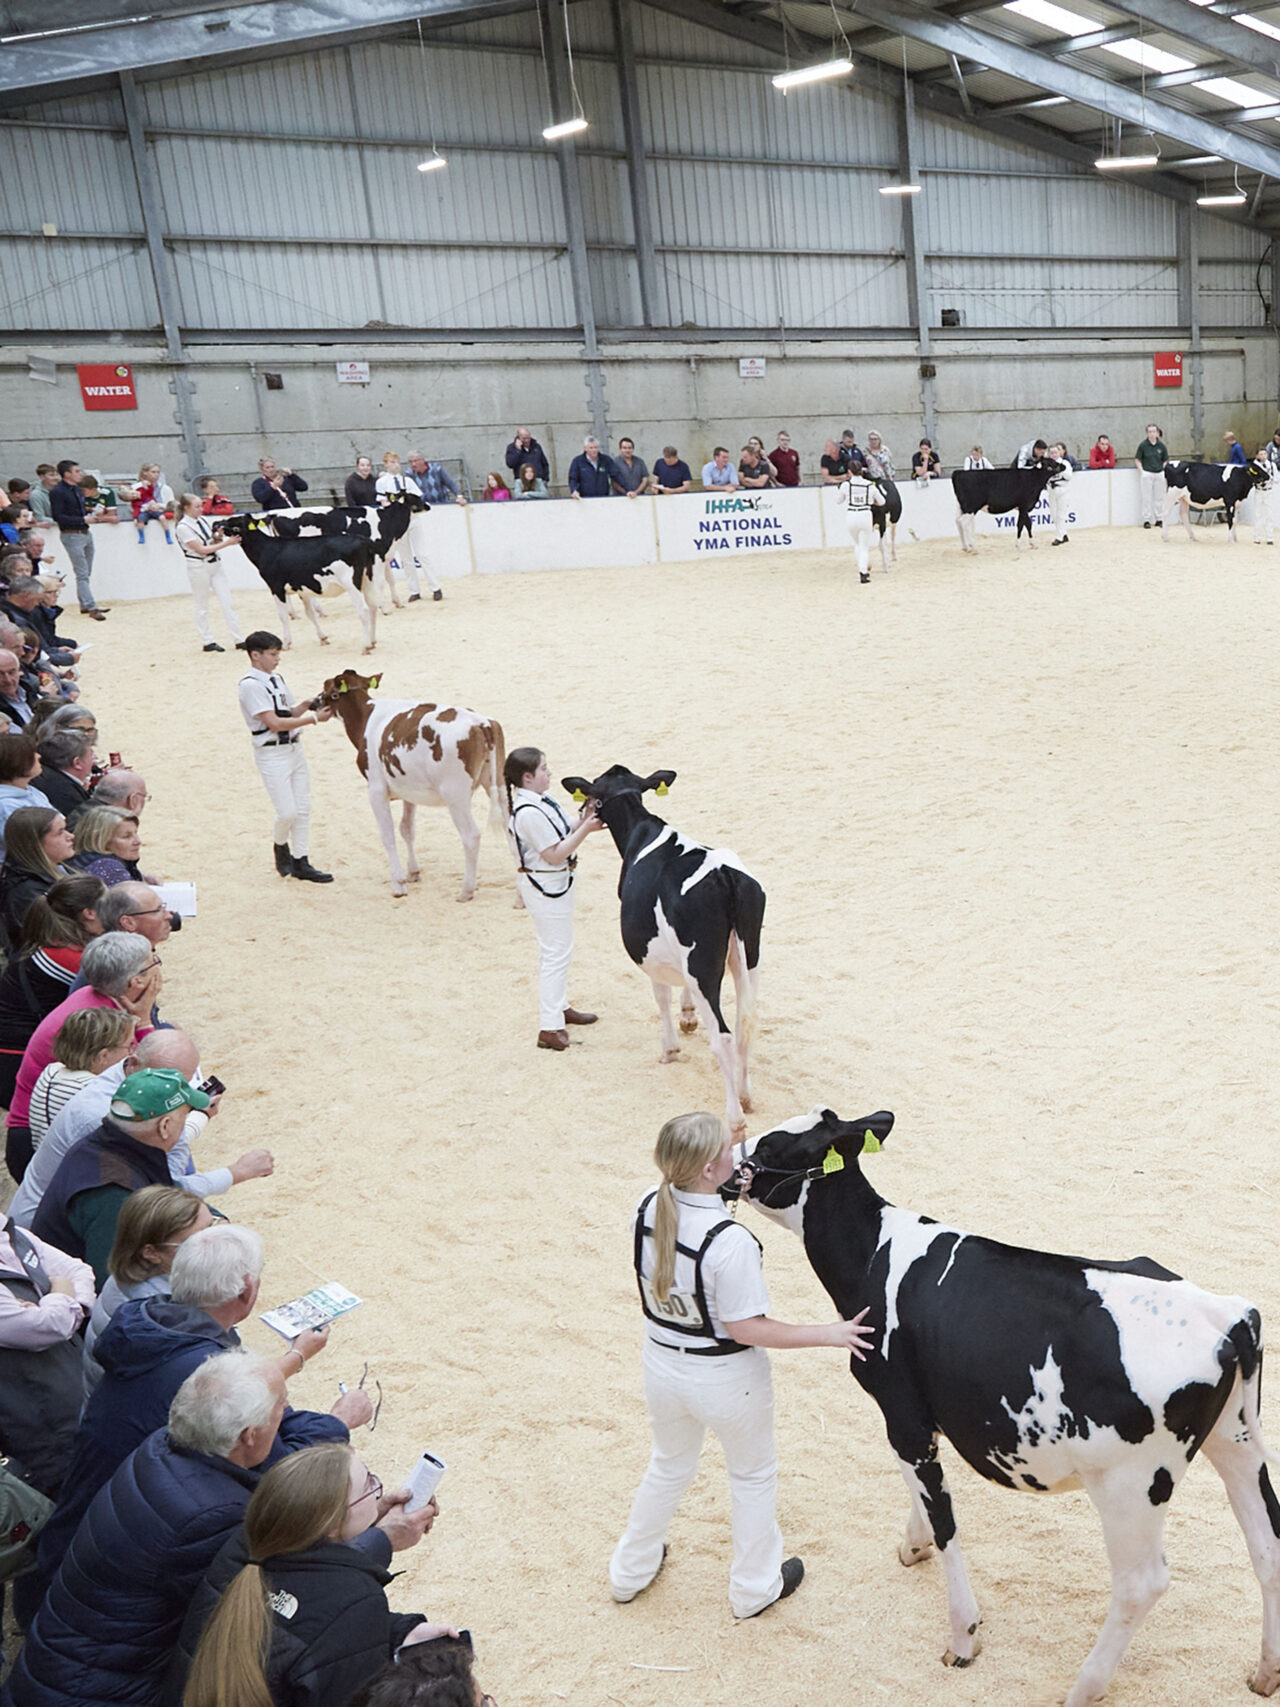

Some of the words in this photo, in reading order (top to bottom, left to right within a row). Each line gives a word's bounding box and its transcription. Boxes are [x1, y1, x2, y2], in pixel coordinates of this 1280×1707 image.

[1156, 368, 1181, 377] WATER
[84, 386, 133, 396] WATER
[705, 498, 745, 514] IHFA
[699, 517, 782, 533] NATIONAL
[995, 516, 1017, 528] YM
[693, 538, 730, 550] YMA
[735, 533, 793, 548] FINALS
